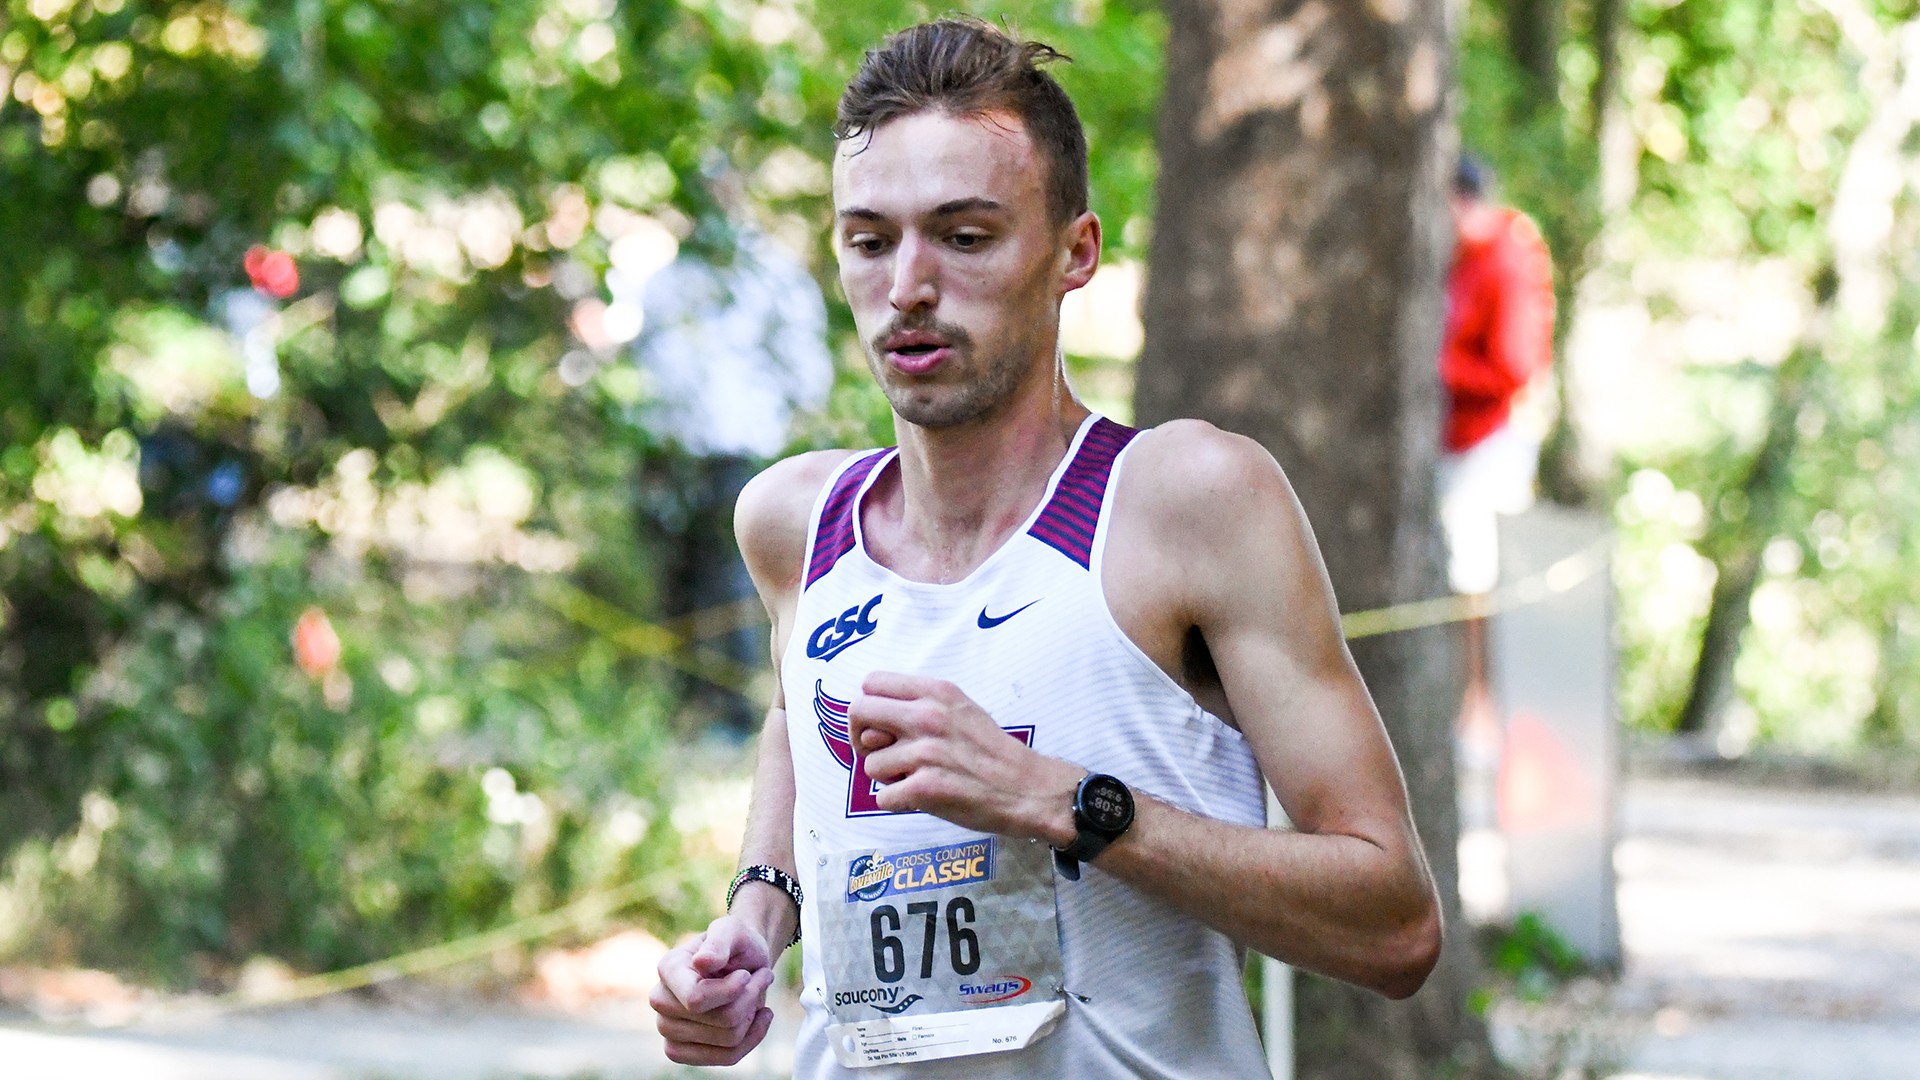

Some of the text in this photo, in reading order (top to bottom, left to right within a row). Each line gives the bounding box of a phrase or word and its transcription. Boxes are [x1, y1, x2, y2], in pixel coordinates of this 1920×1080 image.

[806, 593, 884, 660] GSC
[1094, 797, 1122, 817] 5:08
[896, 843, 988, 869] CROSS COUNTRY
[894, 856, 985, 890] CLASSIC
[870, 896, 981, 983] 676
[835, 986, 899, 1007] saucony
[959, 980, 1020, 997] Swags
